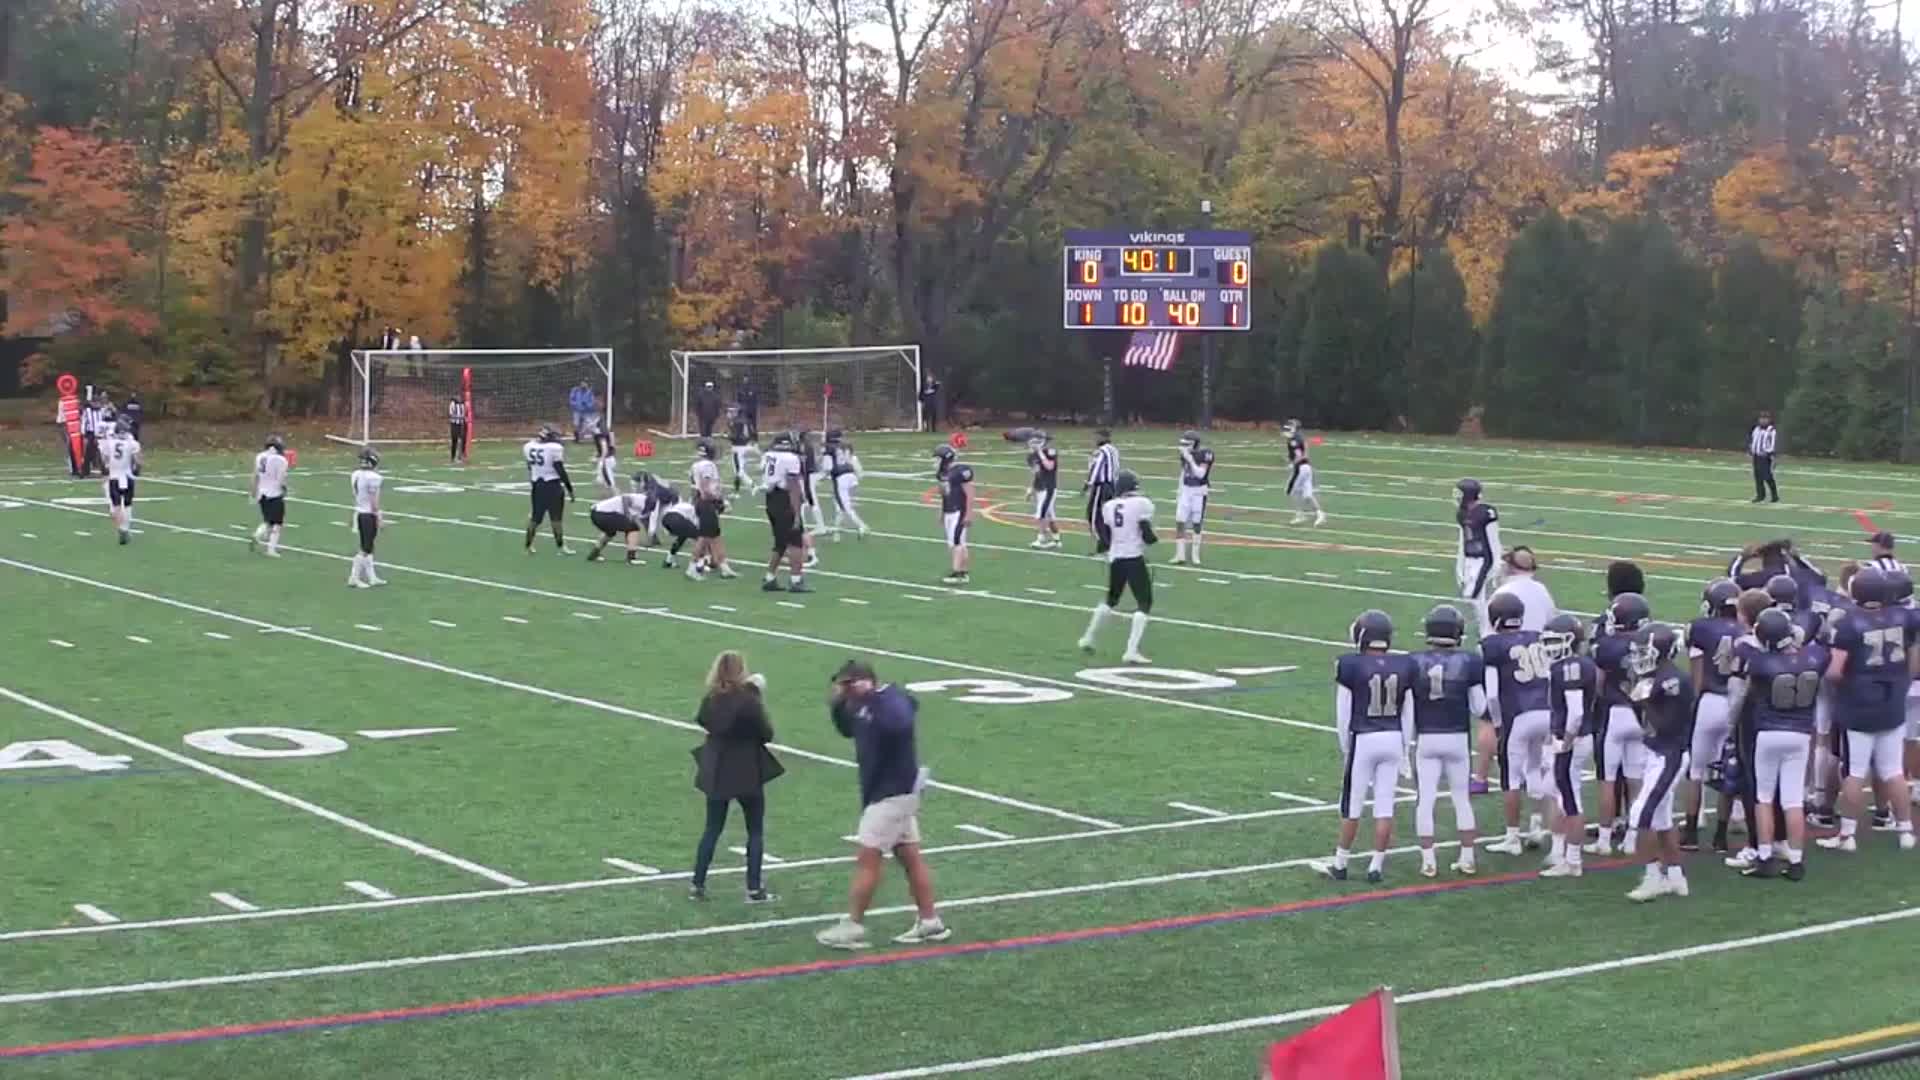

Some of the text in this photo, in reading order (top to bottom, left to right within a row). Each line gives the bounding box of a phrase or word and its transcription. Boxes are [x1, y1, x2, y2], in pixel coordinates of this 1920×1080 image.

[1074, 249, 1102, 261] KING
[1213, 248, 1248, 260] GUEST
[1084, 260, 1097, 283] 0
[1233, 260, 1247, 284] 0
[1066, 289, 1102, 301] DOWN
[1112, 289, 1148, 302] TO GO
[1163, 289, 1206, 302] BALL ON
[1219, 289, 1243, 303] QTR
[1085, 303, 1092, 323] 1
[1122, 302, 1146, 325] 10
[1168, 302, 1200, 325] 40
[1231, 303, 1238, 325] 1
[114, 442, 124, 460] 5
[528, 448, 545, 467] 55
[1113, 503, 1125, 528] 6
[1427, 664, 1445, 700] 1
[1367, 673, 1398, 717] 11
